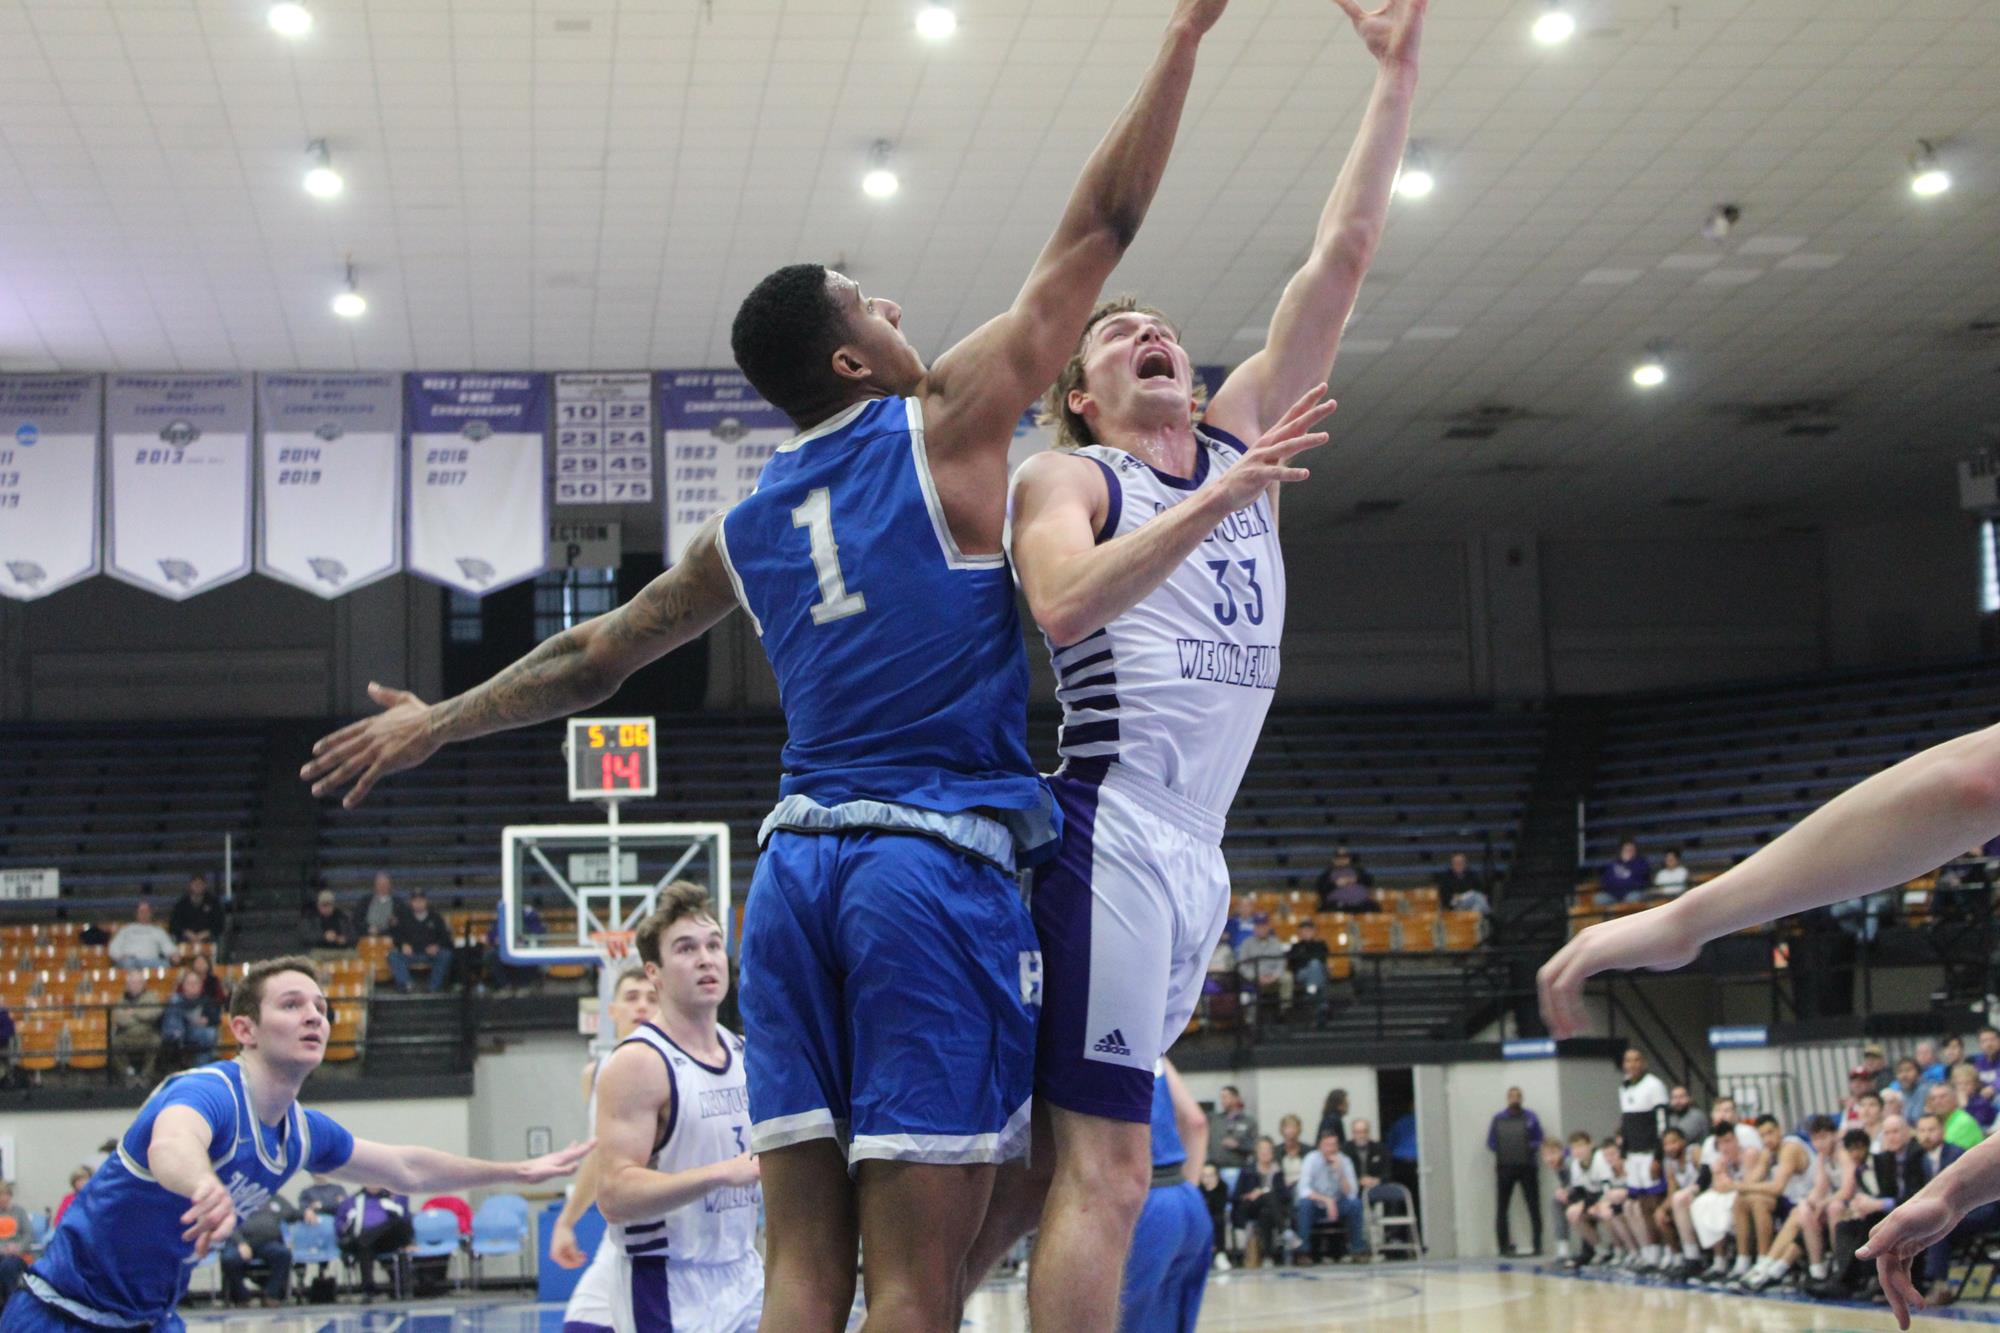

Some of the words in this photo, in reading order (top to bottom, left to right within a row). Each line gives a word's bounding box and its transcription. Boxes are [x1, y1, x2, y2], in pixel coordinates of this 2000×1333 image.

[563, 405, 597, 419] 10
[609, 405, 645, 418] 22
[561, 431, 597, 445] 23
[609, 431, 646, 445] 24
[0, 449, 14, 465] 11
[562, 457, 597, 471] 29
[610, 457, 647, 471] 45
[561, 483, 597, 497] 50
[612, 483, 647, 497] 75
[791, 486, 867, 626] 1
[1206, 558, 1264, 626] 33
[601, 751, 641, 792] 14
